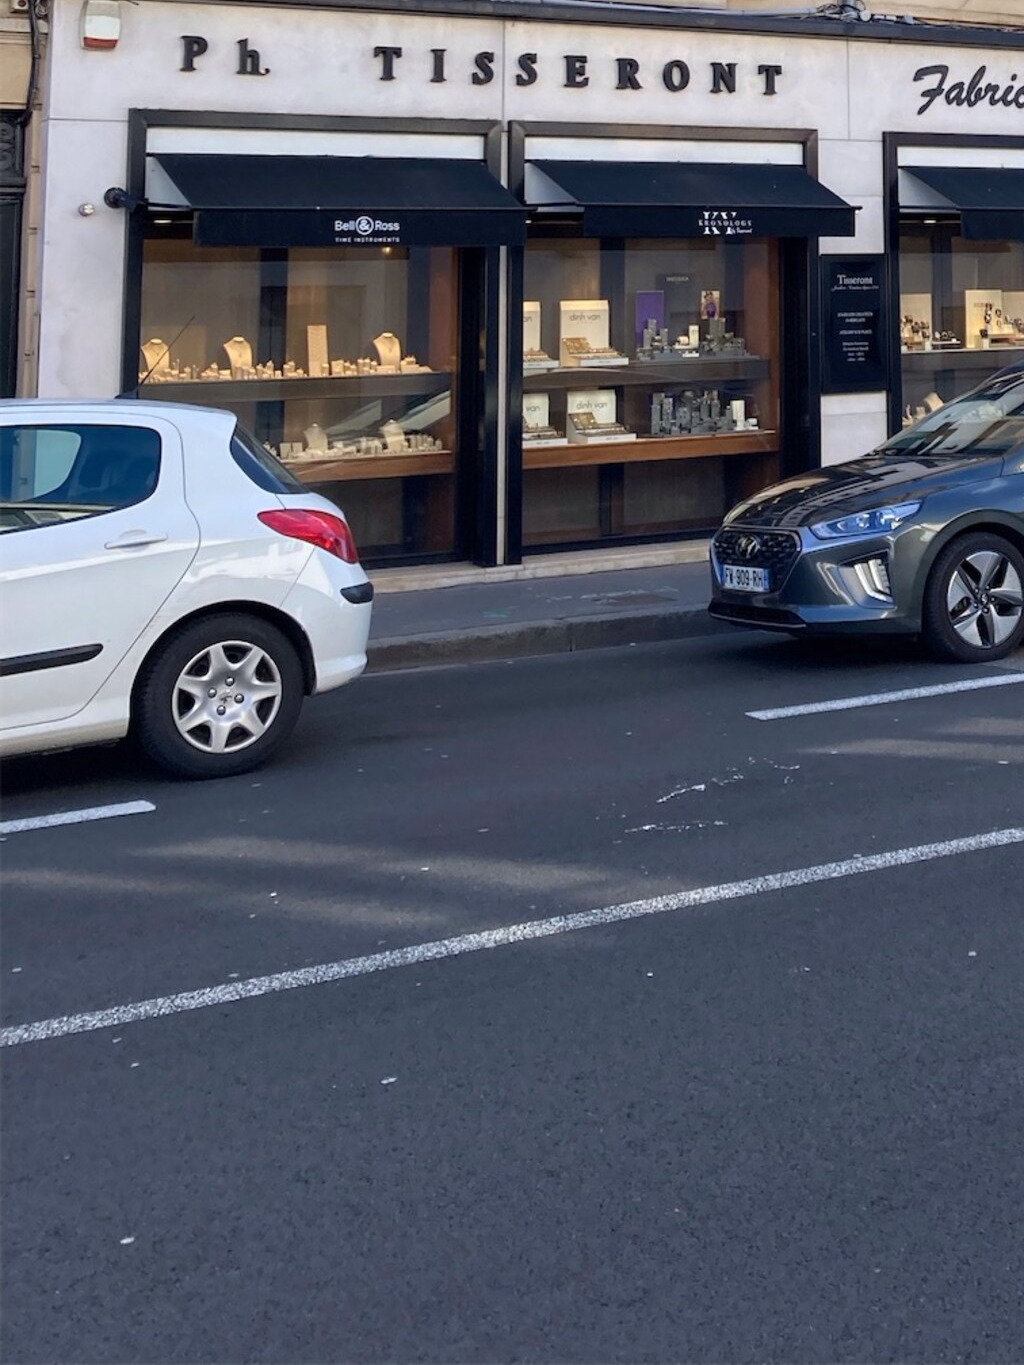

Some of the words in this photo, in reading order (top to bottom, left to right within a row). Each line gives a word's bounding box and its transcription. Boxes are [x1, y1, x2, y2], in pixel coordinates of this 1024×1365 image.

[373, 47, 783, 95] TISSERONT
[334, 220, 356, 231] Bell
[374, 220, 400, 231] Ross
